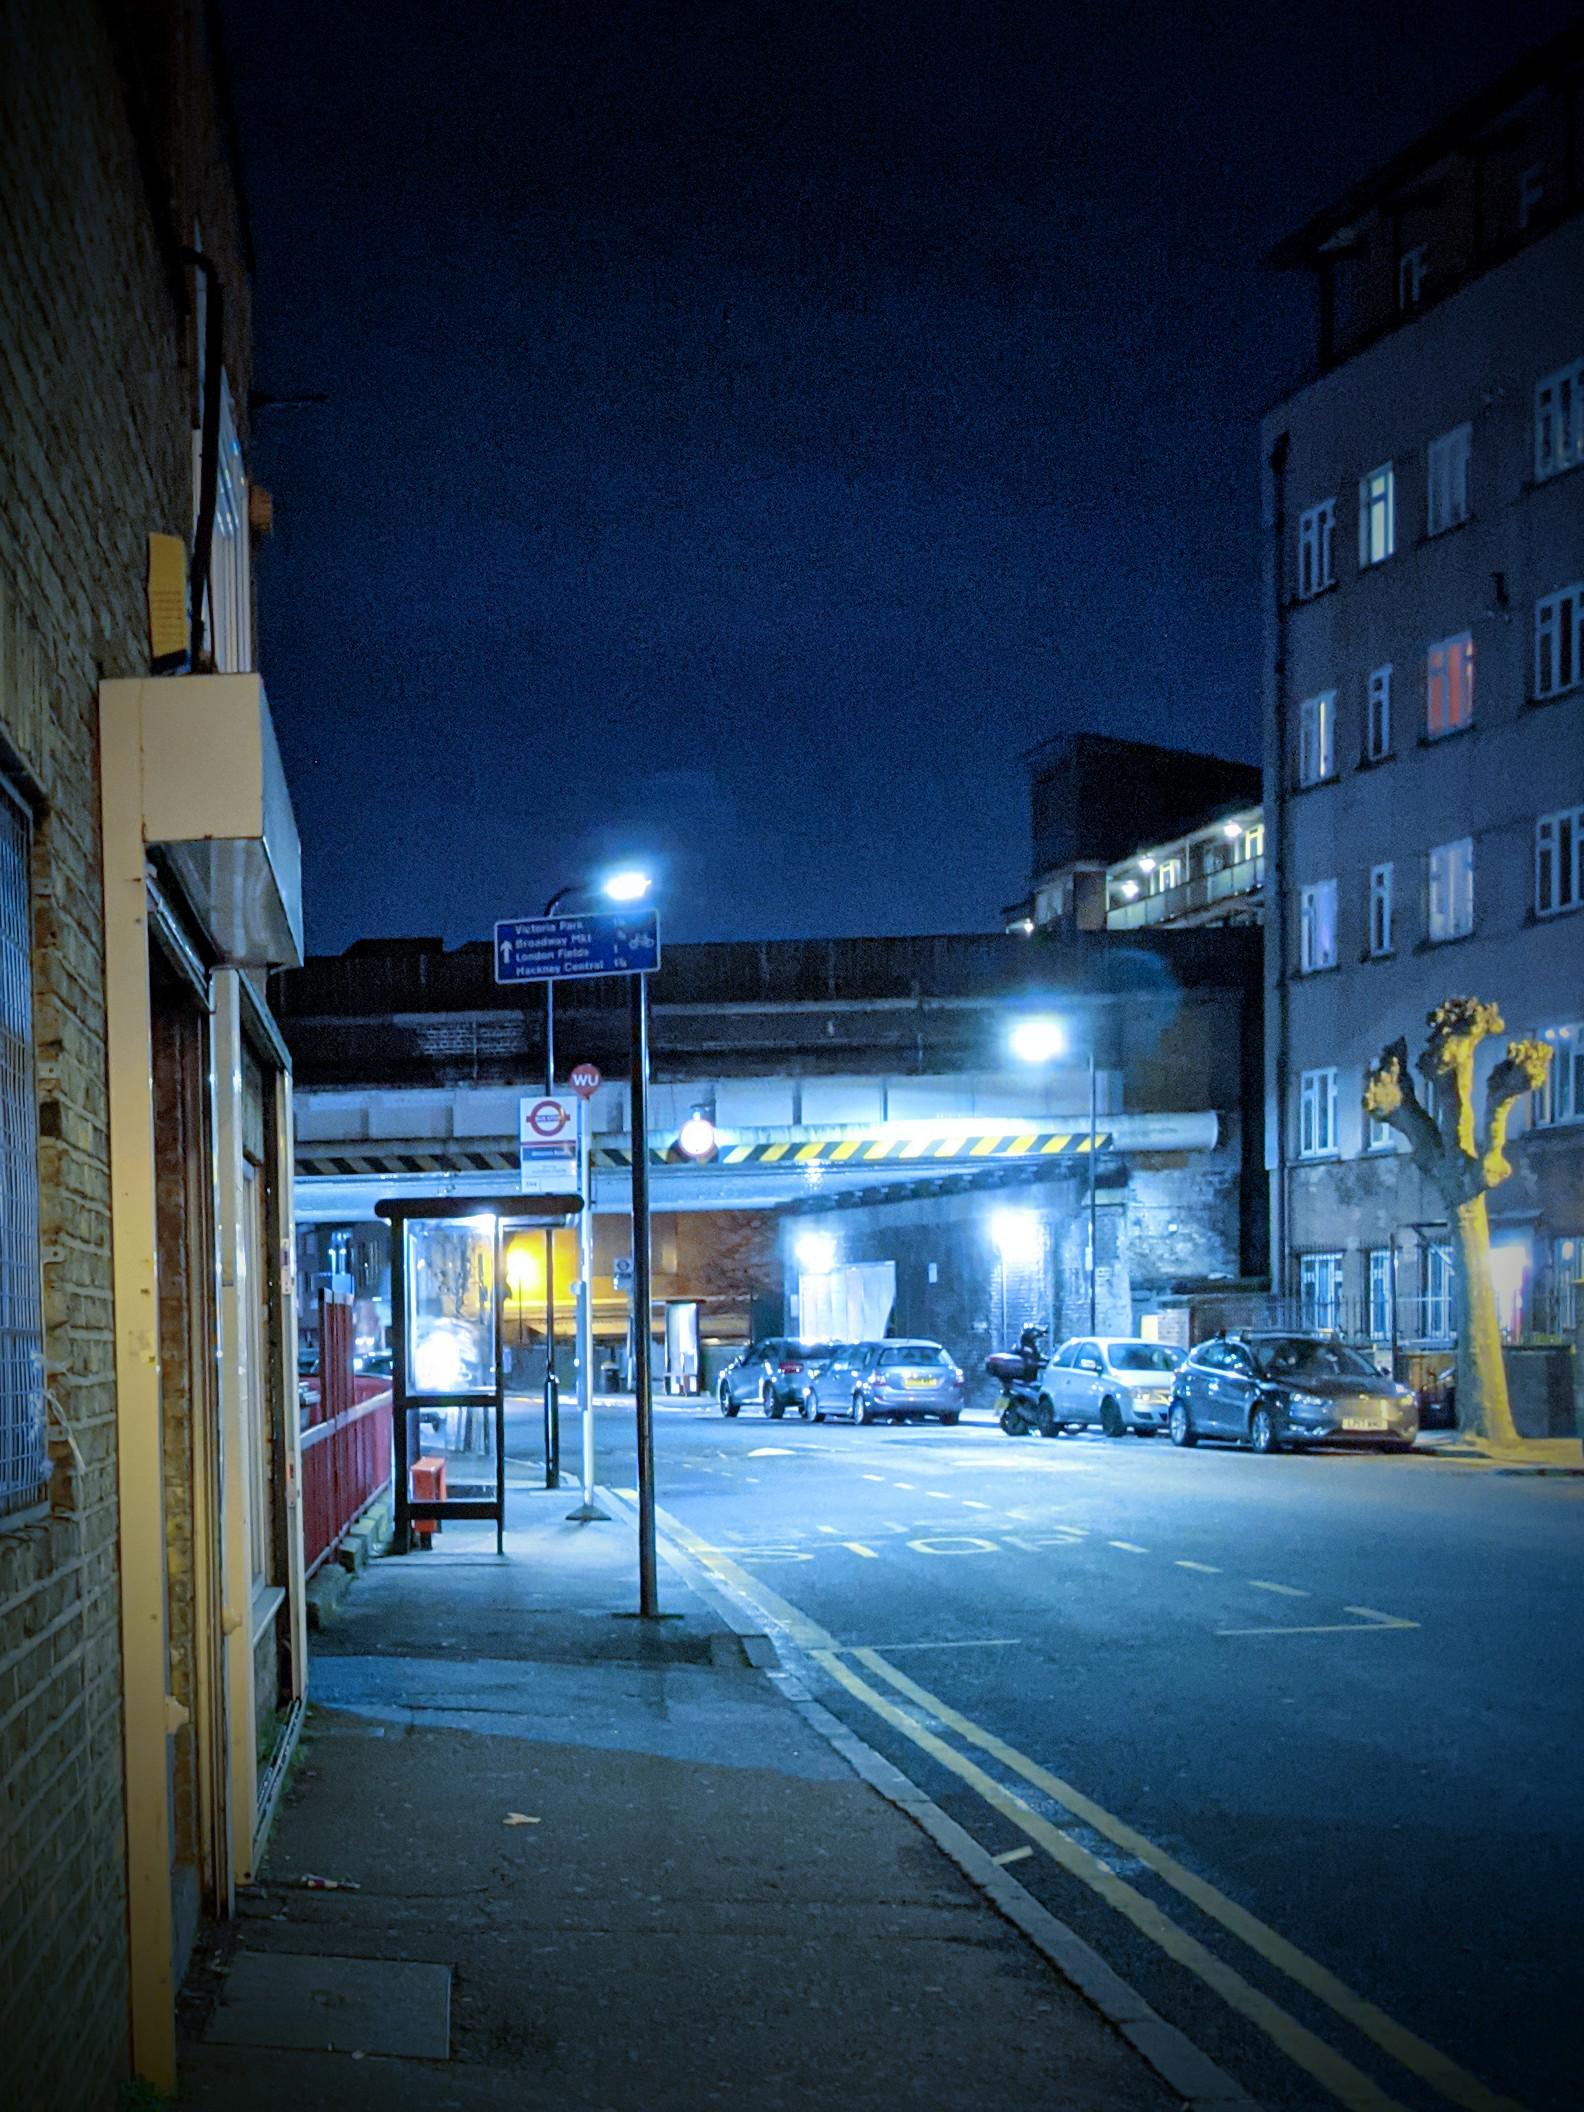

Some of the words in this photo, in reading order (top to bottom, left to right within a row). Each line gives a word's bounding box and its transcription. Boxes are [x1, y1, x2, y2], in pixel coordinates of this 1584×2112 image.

[515, 922, 556, 935] Victoria
[559, 920, 584, 931] Park
[515, 936, 568, 950] Broadway
[571, 934, 592, 944] Mkt
[515, 951, 555, 962] London
[558, 948, 590, 959] Fields
[515, 963, 561, 977] Hackney
[564, 960, 605, 972] Central
[572, 1074, 600, 1087] WU
[714, 1534, 1084, 1564] STOP
